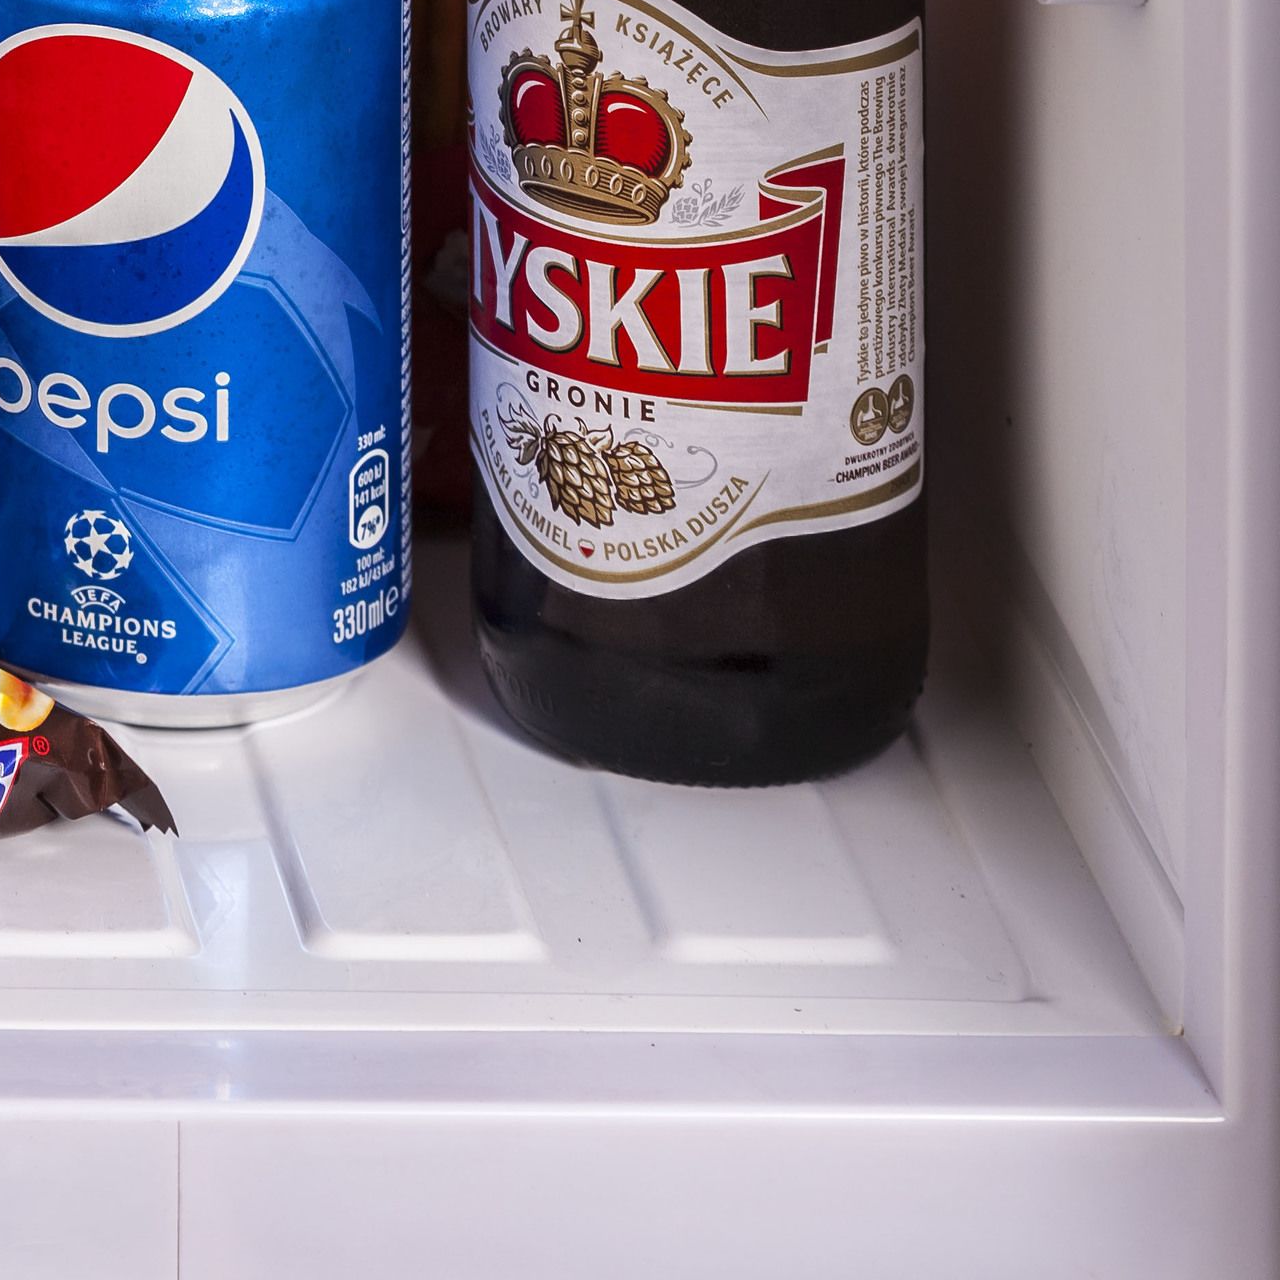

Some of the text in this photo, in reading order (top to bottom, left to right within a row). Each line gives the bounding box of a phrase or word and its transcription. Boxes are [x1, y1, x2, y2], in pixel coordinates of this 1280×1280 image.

[615, 13, 734, 110] KSIĄŻĘCE
[526, 369, 657, 422] GRONIE
[357, 468, 373, 487] 600
[836, 453, 900, 483] CHAMPION BEER
[354, 490, 369, 509] 141
[481, 409, 751, 562] POLSKI CHMIEL POLSKA DUSZA
[74, 590, 121, 613] UEFA
[27, 597, 177, 641] CHAMPIONS
[62, 628, 138, 656] LEAGUE
